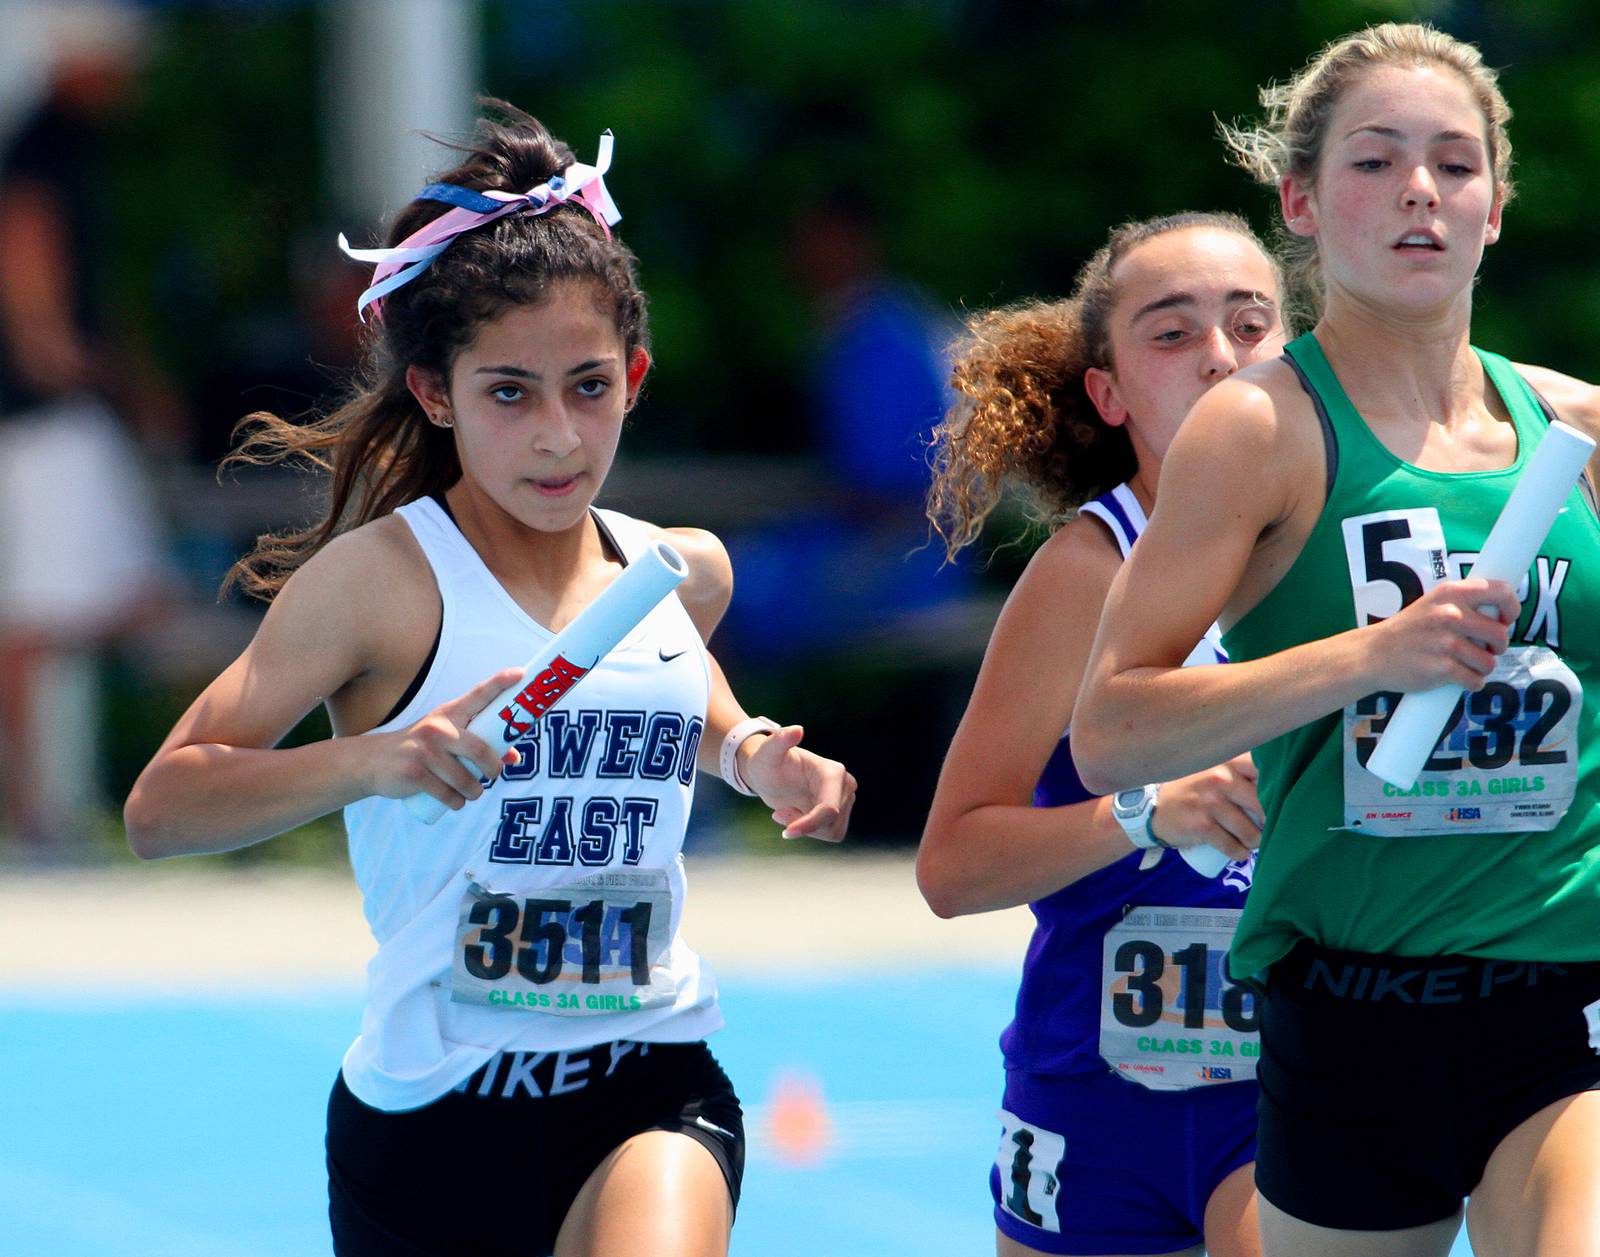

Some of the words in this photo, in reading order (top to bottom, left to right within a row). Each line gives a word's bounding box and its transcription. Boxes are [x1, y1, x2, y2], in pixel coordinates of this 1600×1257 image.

[1362, 518, 1424, 626] 5
[480, 707, 704, 790] SWEGO
[1456, 779, 1482, 797] 3A
[1487, 775, 1546, 795] GIRLS
[488, 796, 659, 867] EAST
[463, 896, 653, 986] 3511
[488, 988, 552, 1009] CLASS
[556, 991, 581, 1010] 3A
[585, 993, 642, 1011] GIRLS
[1303, 958, 1468, 1005] NIKE
[1136, 1036, 1203, 1055] CLASS
[1209, 1040, 1234, 1057] 3A
